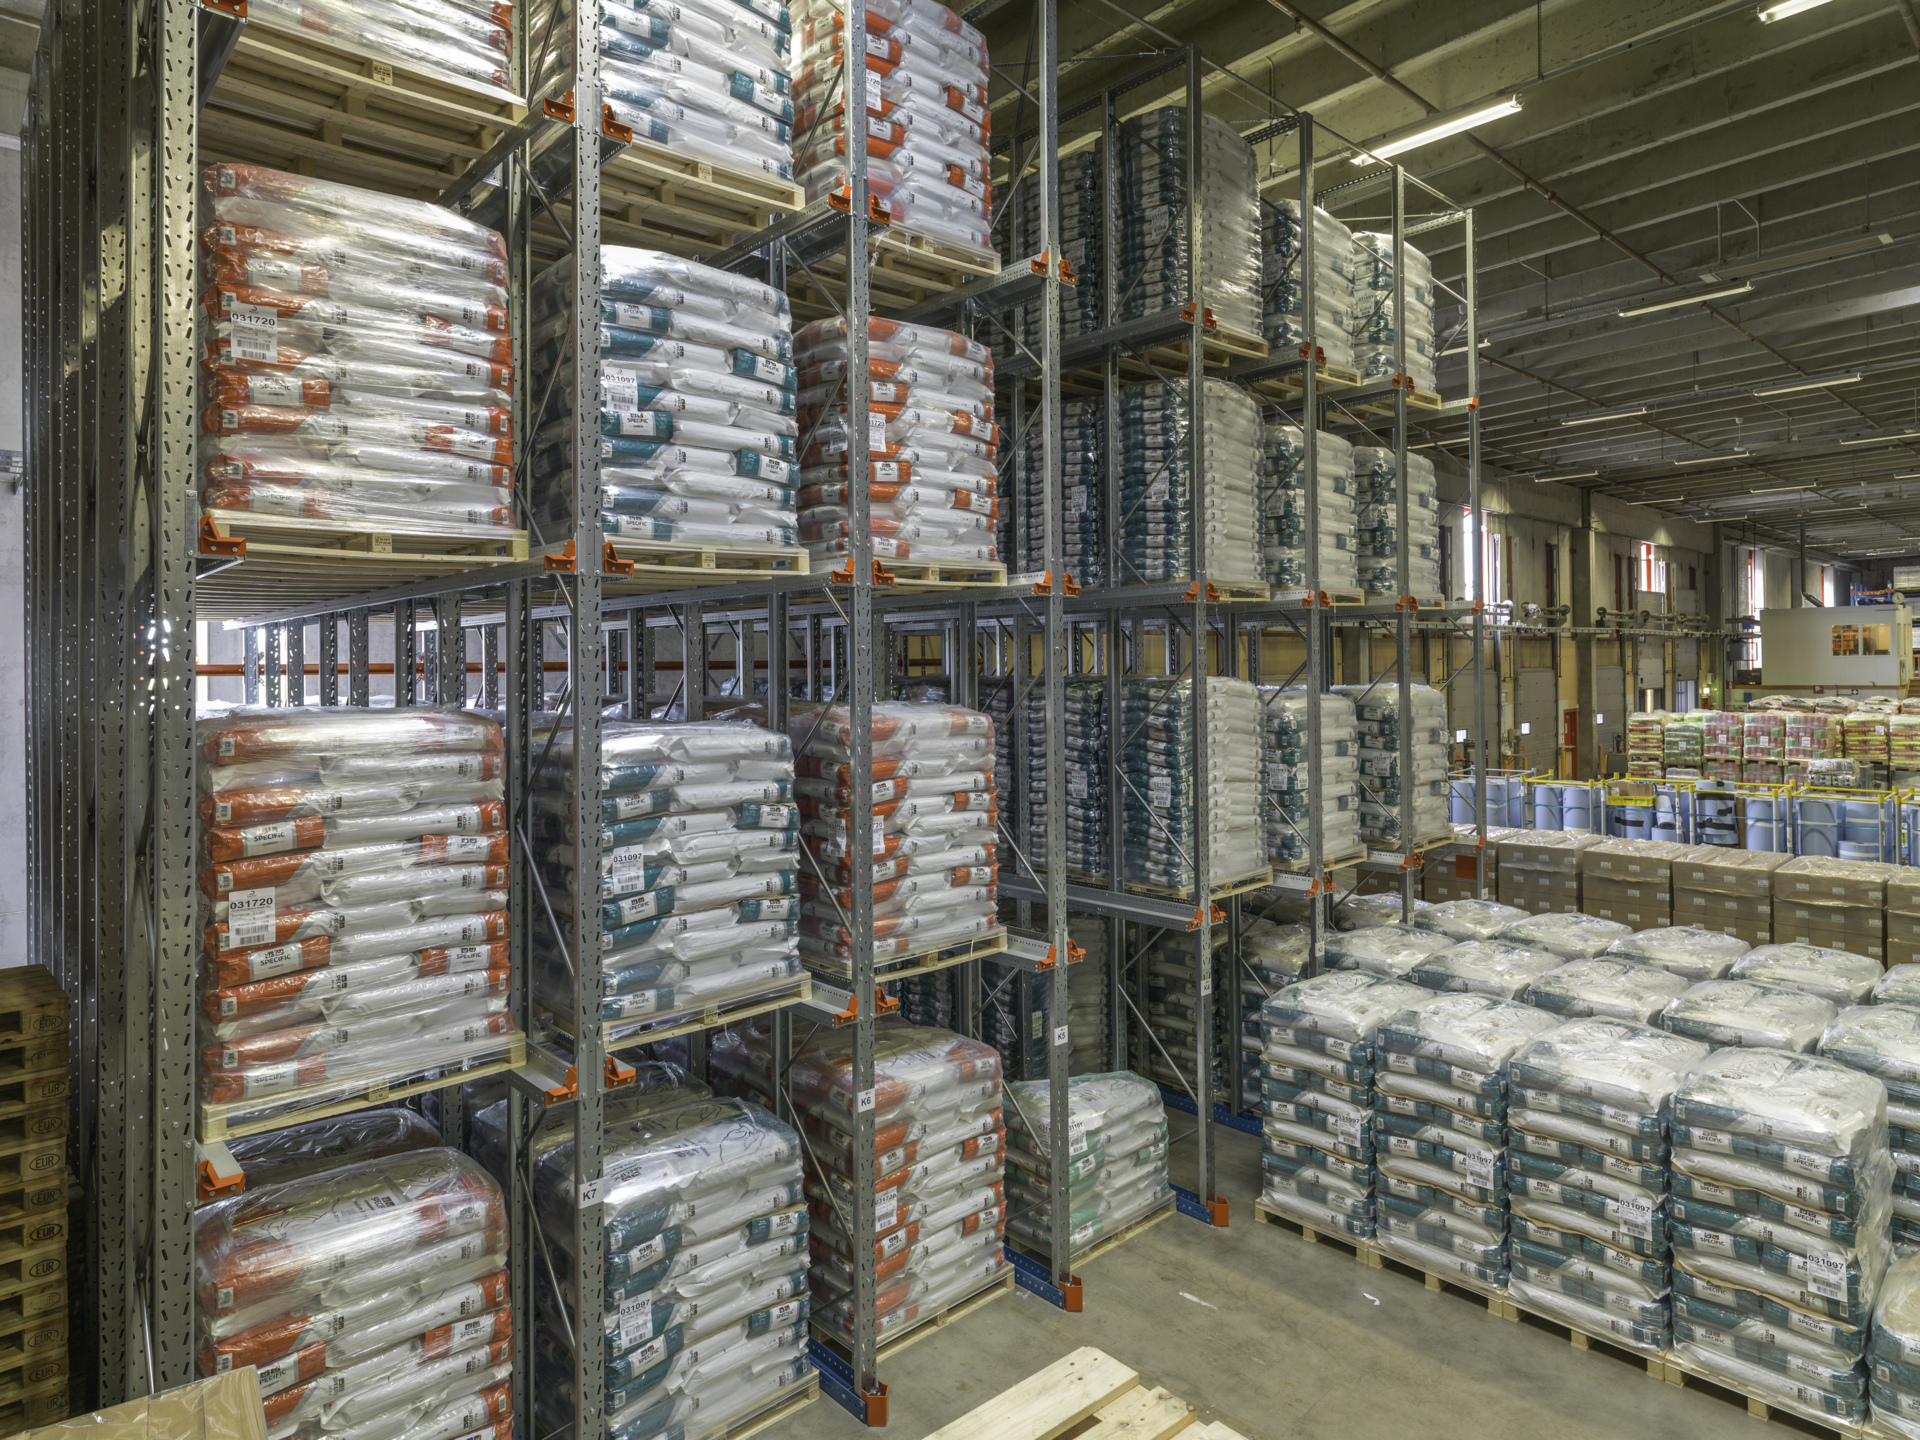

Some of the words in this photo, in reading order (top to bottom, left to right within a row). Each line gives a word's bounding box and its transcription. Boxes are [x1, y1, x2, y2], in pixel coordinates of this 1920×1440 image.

[623, 308, 644, 316] SPECIFIC
[231, 313, 276, 326] 031720
[605, 375, 635, 383] 031097
[625, 799, 646, 807] SPECIFIC
[253, 831, 285, 843] SPECIFIC
[613, 853, 642, 863] 031097
[229, 897, 273, 910] 031720
[629, 902, 650, 911] SPECIFIC
[260, 954, 291, 966] SPECIFIC
[456, 951, 481, 959] SPECIFIC
[629, 998, 650, 1006] SPECIFIC
[39, 1017, 56, 1028] EUR
[1058, 1032, 1065, 1040] K5
[255, 1072, 286, 1083] SPECIFIC
[1457, 1075, 1475, 1084] SPECIFIC
[42, 1083, 60, 1095] EUR
[861, 1097, 871, 1107] K6
[1338, 1115, 1360, 1124] 031097
[1458, 1117, 1477, 1128] SPECIFIC
[1609, 1114, 1631, 1125] SPECIFIC
[38, 1120, 55, 1131] EUR
[1699, 1135, 1723, 1143] SPECIFIC
[36, 1156, 54, 1168] EUR
[1467, 1153, 1492, 1164] 031097
[1793, 1158, 1819, 1169] SPECIFIC
[1610, 1162, 1633, 1173] SPECIFIC
[38, 1191, 55, 1202] EUR
[582, 1188, 597, 1201] K7
[875, 1193, 897, 1205] 031720
[1459, 1204, 1478, 1213] SPECIFIC
[1620, 1199, 1650, 1212] 031097
[1793, 1213, 1820, 1225] SPECIFIC
[36, 1225, 55, 1238] EUR
[1533, 1229, 1553, 1237] SPECIFIC
[887, 1239, 903, 1249] SPECIFIC
[1701, 1238, 1725, 1246] SPECIFIC
[637, 1248, 658, 1261] SPECIFIC
[36, 1261, 54, 1273] EUR
[1611, 1256, 1633, 1268] SPECIFIC
[1809, 1254, 1844, 1270] 031097
[1534, 1273, 1554, 1282] SPECIFIC
[1702, 1285, 1726, 1295] SPECIFIC
[620, 1299, 651, 1315] 031097
[1611, 1299, 1633, 1310] SPECIFIC
[1798, 1318, 1825, 1332] SPECIFIC
[33, 1332, 52, 1345] EUR
[1701, 1334, 1725, 1344] SPECIFIC
[638, 1348, 659, 1364] SPECIFIC
[34, 1366, 54, 1378] EUR
[259, 1369, 287, 1385] PECIFIC
[1796, 1365, 1823, 1378] SPECIFIC
[46, 1397, 58, 1409] UR
